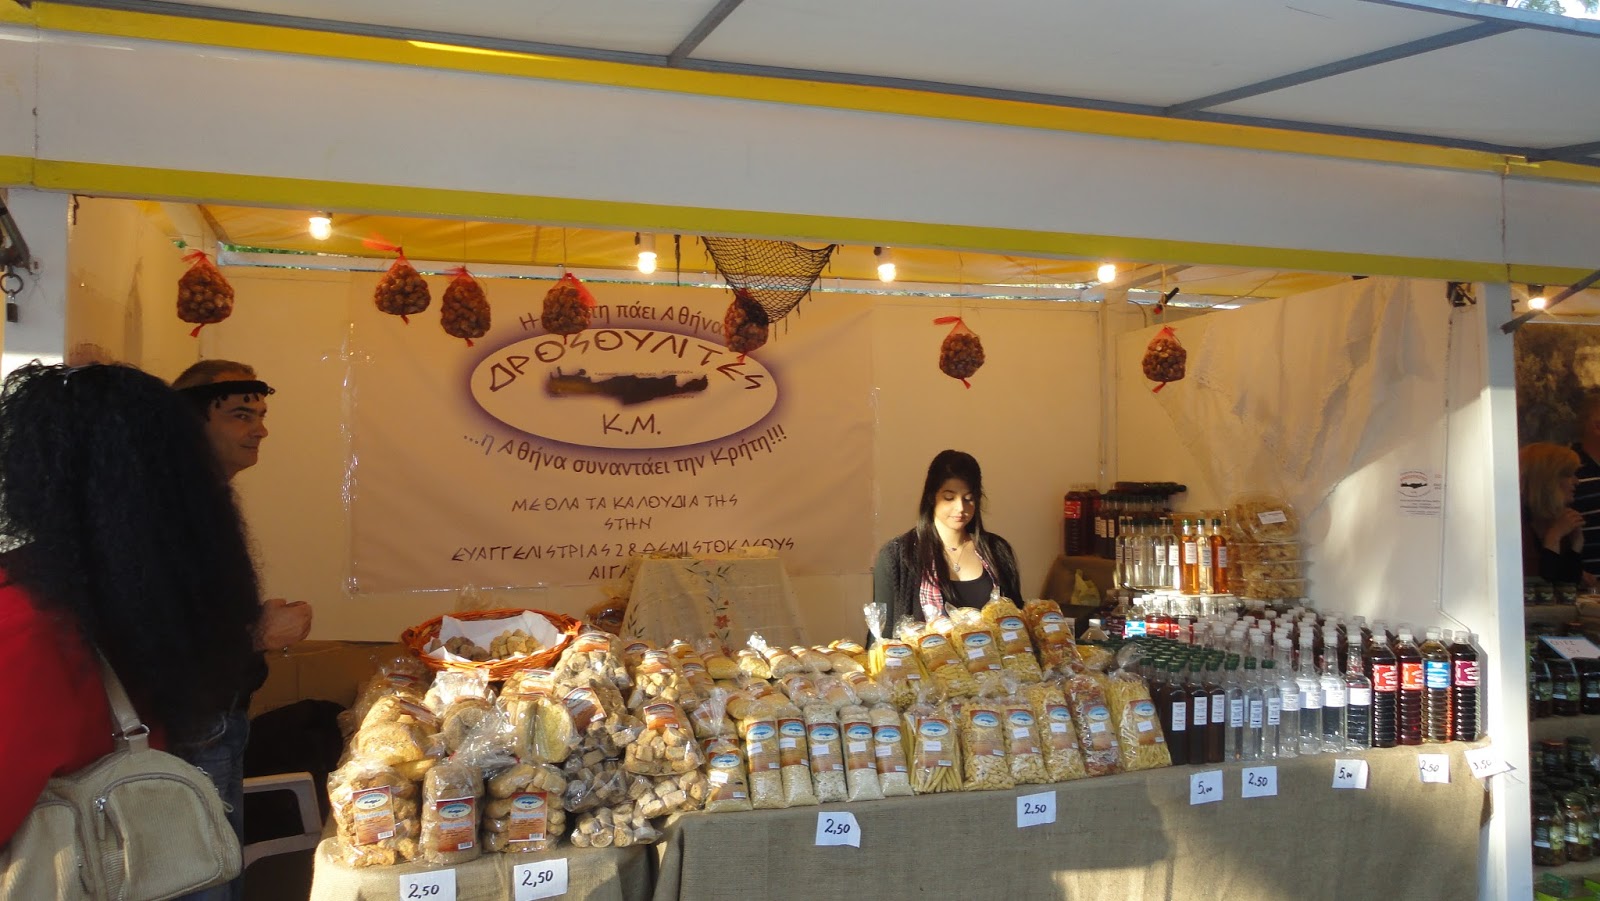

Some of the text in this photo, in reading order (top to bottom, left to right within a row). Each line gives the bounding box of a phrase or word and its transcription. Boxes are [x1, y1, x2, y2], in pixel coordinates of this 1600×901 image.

[616, 303, 656, 321] πάει
[602, 413, 662, 435] Κ.Μ.
[498, 437, 566, 472] Αθήνα
[572, 456, 670, 477] συναντάει
[673, 456, 705, 476] την
[710, 424, 788, 465] Κρήτη!!!
[585, 496, 607, 510] ΤΑ
[704, 493, 739, 508] ΤΗΣ
[604, 516, 652, 531] ΣΤΗΝ
[615, 543, 624, 557] 2
[824, 818, 851, 835] 2,50
[522, 869, 554, 887] 2,50
[408, 883, 440, 899] 2,50
